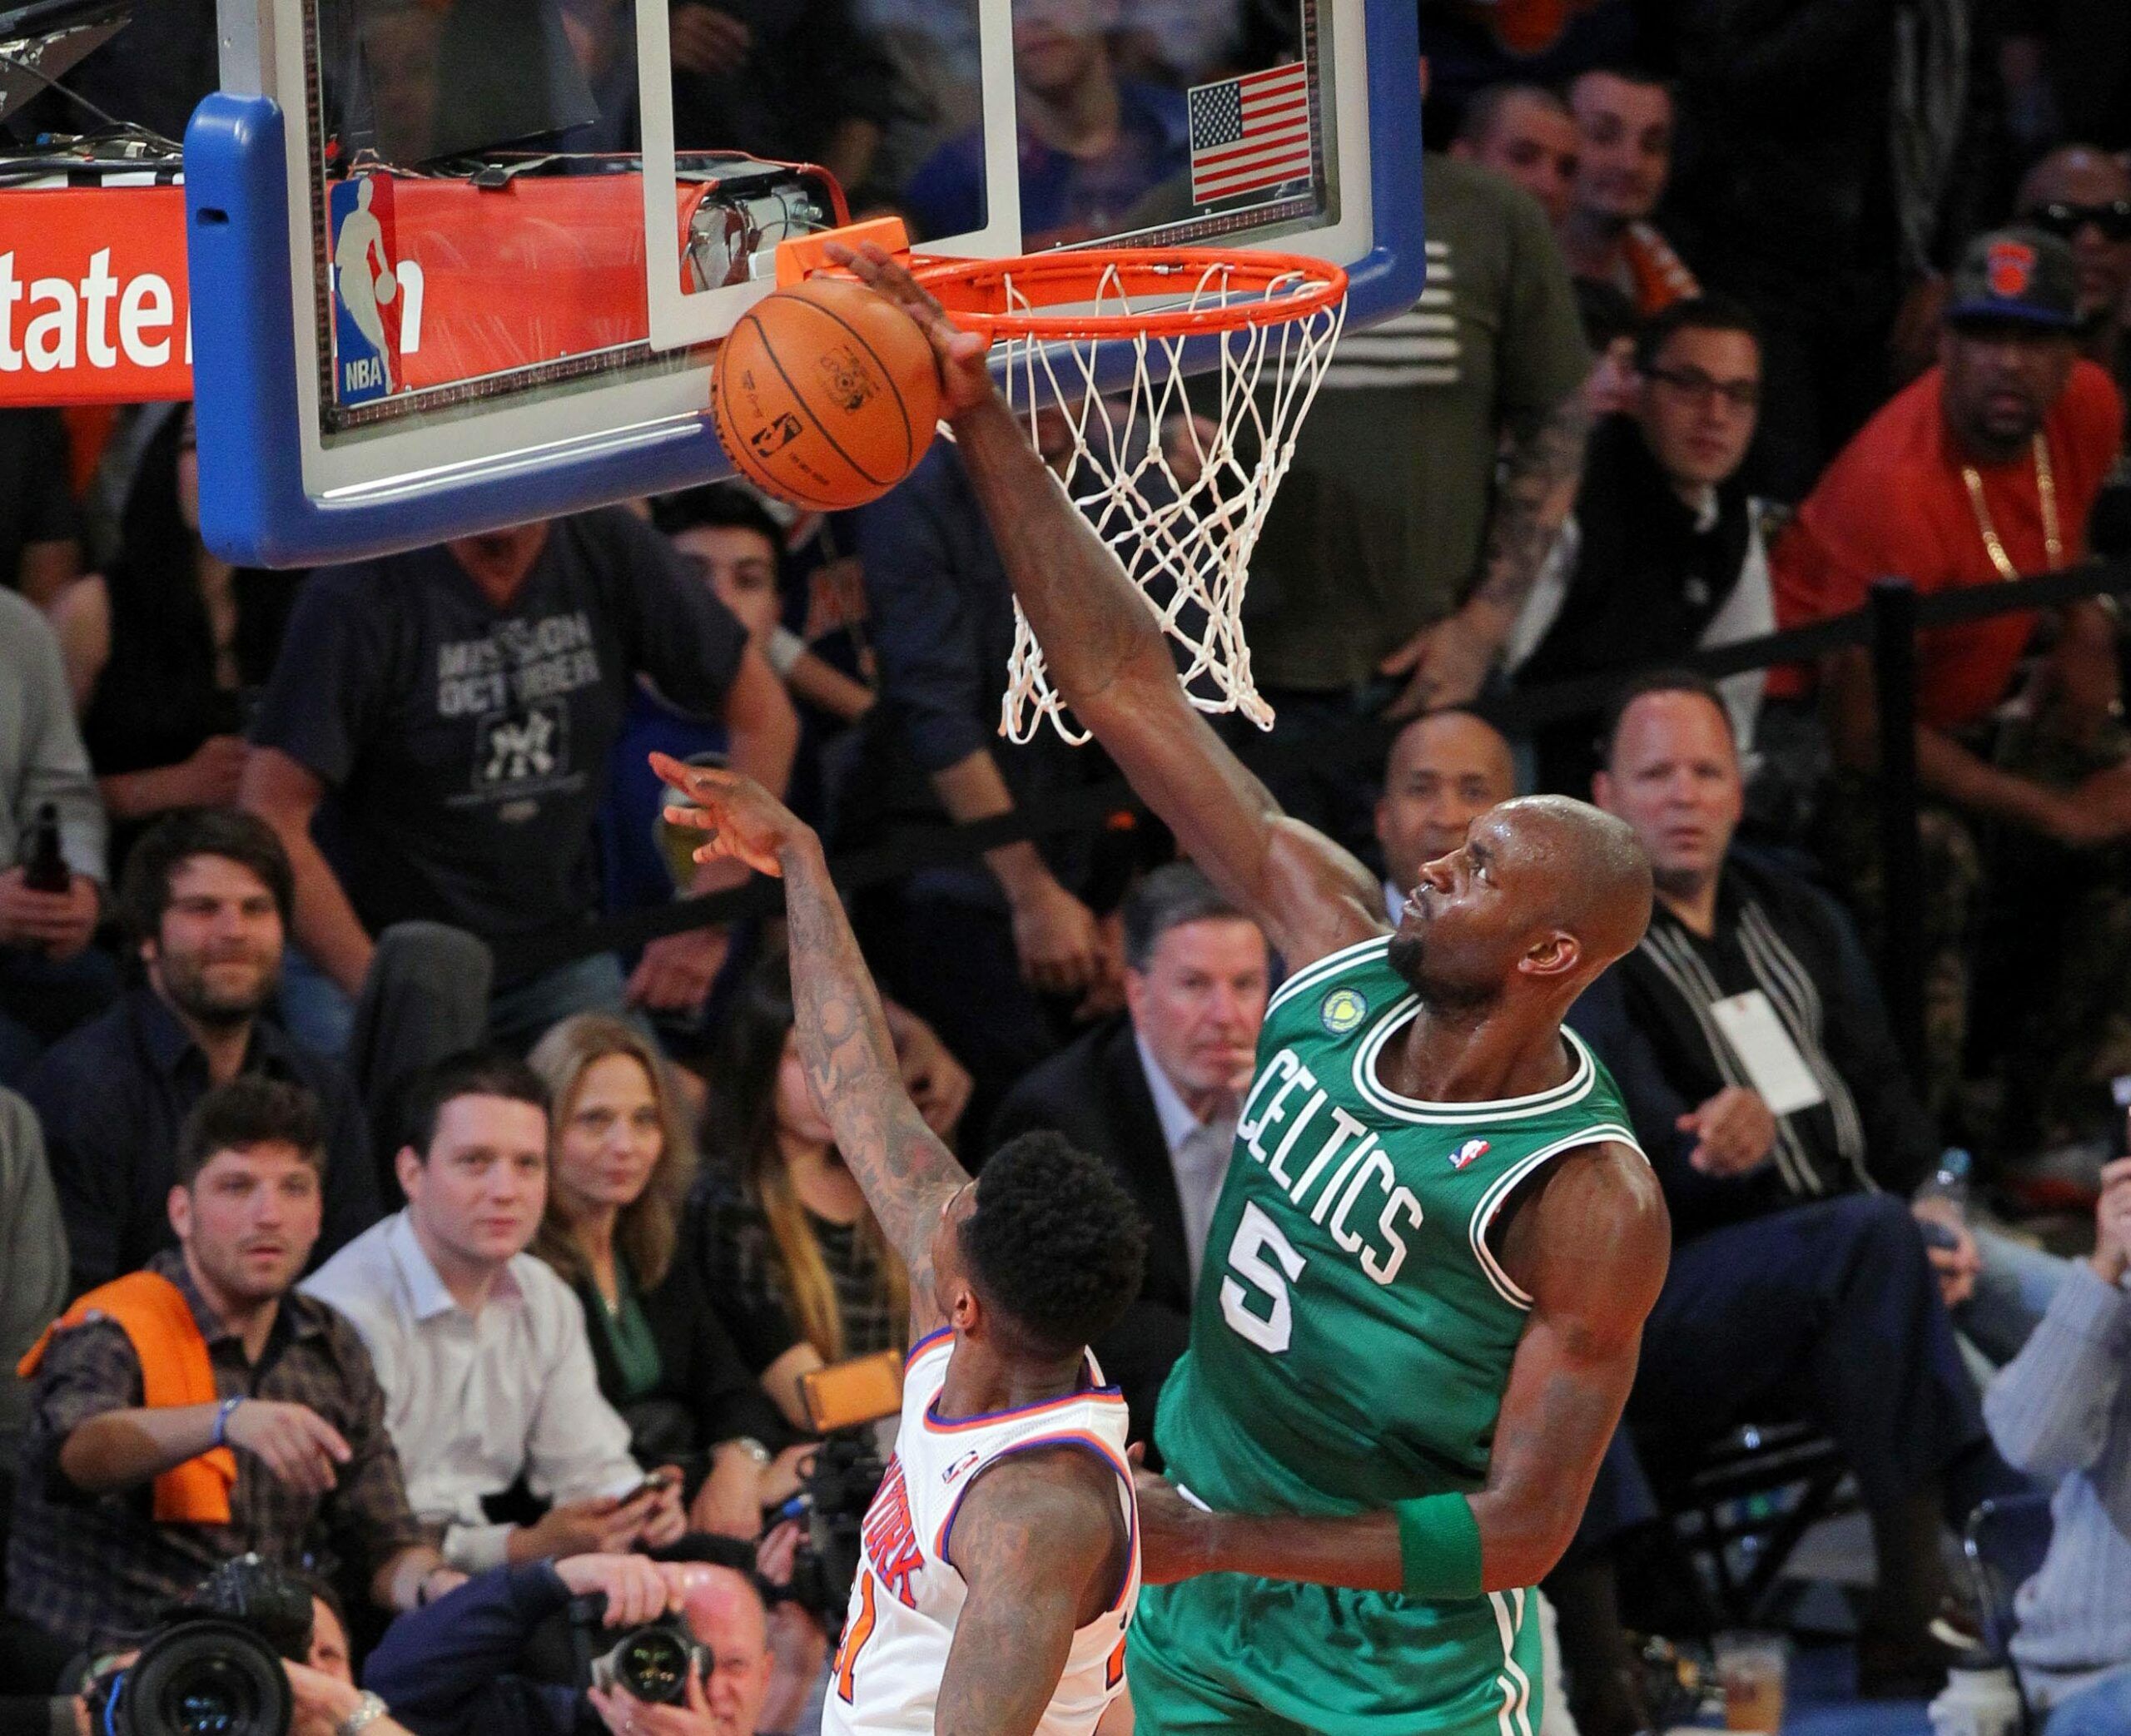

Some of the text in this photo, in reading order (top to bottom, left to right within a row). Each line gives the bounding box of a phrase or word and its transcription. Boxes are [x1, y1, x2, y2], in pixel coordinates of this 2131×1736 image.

[345, 356, 383, 393] NBA
[438, 650, 601, 716] OCTBER
[1237, 1048, 1424, 1286] CELTICS
[1219, 1200, 1307, 1354] 5
[833, 1568, 877, 1706] 1
